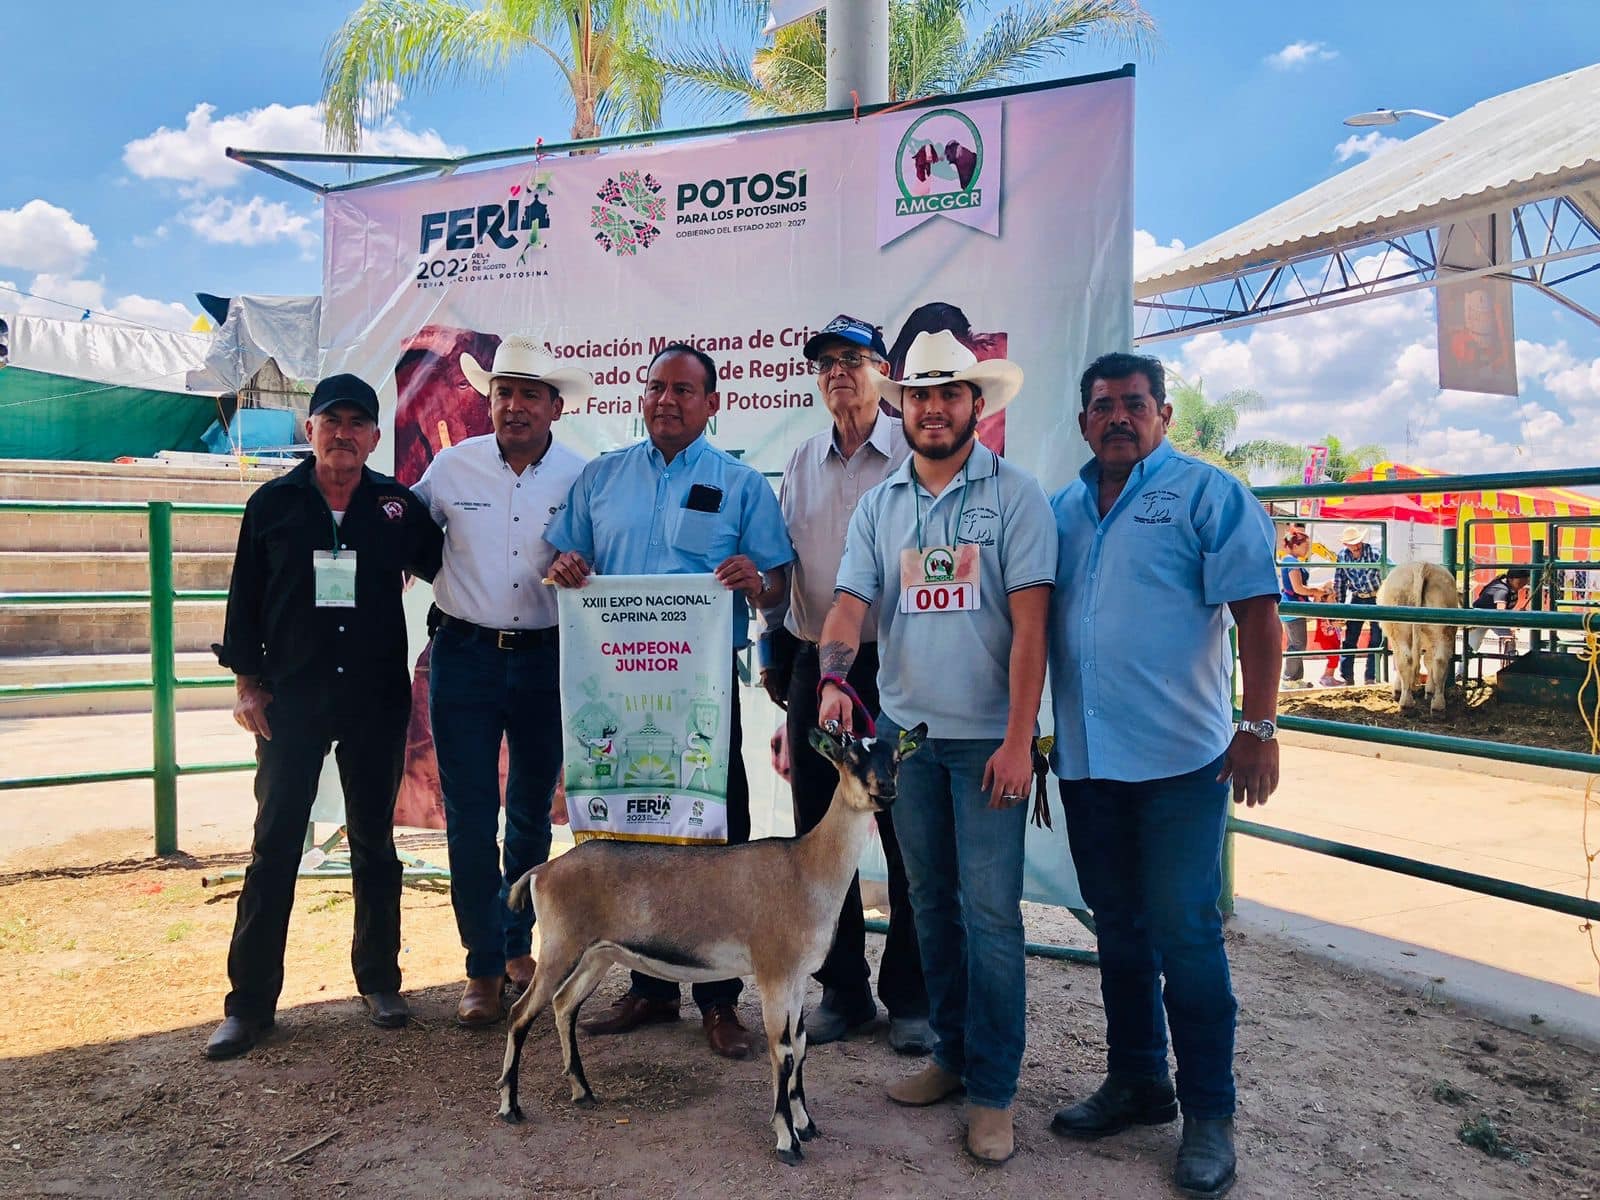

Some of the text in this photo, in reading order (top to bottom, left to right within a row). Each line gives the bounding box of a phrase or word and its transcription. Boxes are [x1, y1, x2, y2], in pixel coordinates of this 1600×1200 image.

[896, 191, 981, 214] AMCGCR
[676, 201, 807, 224] PARA LOS POTOSINOS
[676, 219, 806, 238] GOBIERNO DEL ESTADO 2021 2027
[499, 270, 549, 279] POTOSINA
[748, 330, 774, 349] de
[719, 361, 744, 380] de
[587, 396, 631, 414] Feria
[727, 389, 814, 411] Potosina
[582, 595, 711, 608] XXIII EXPO NACIONAL
[916, 587, 964, 610] 001
[601, 611, 687, 623] CAPRINA 2023
[601, 641, 692, 655] CAMPEONA
[615, 658, 679, 672] JUNIOR
[625, 694, 672, 713] ALPINA
